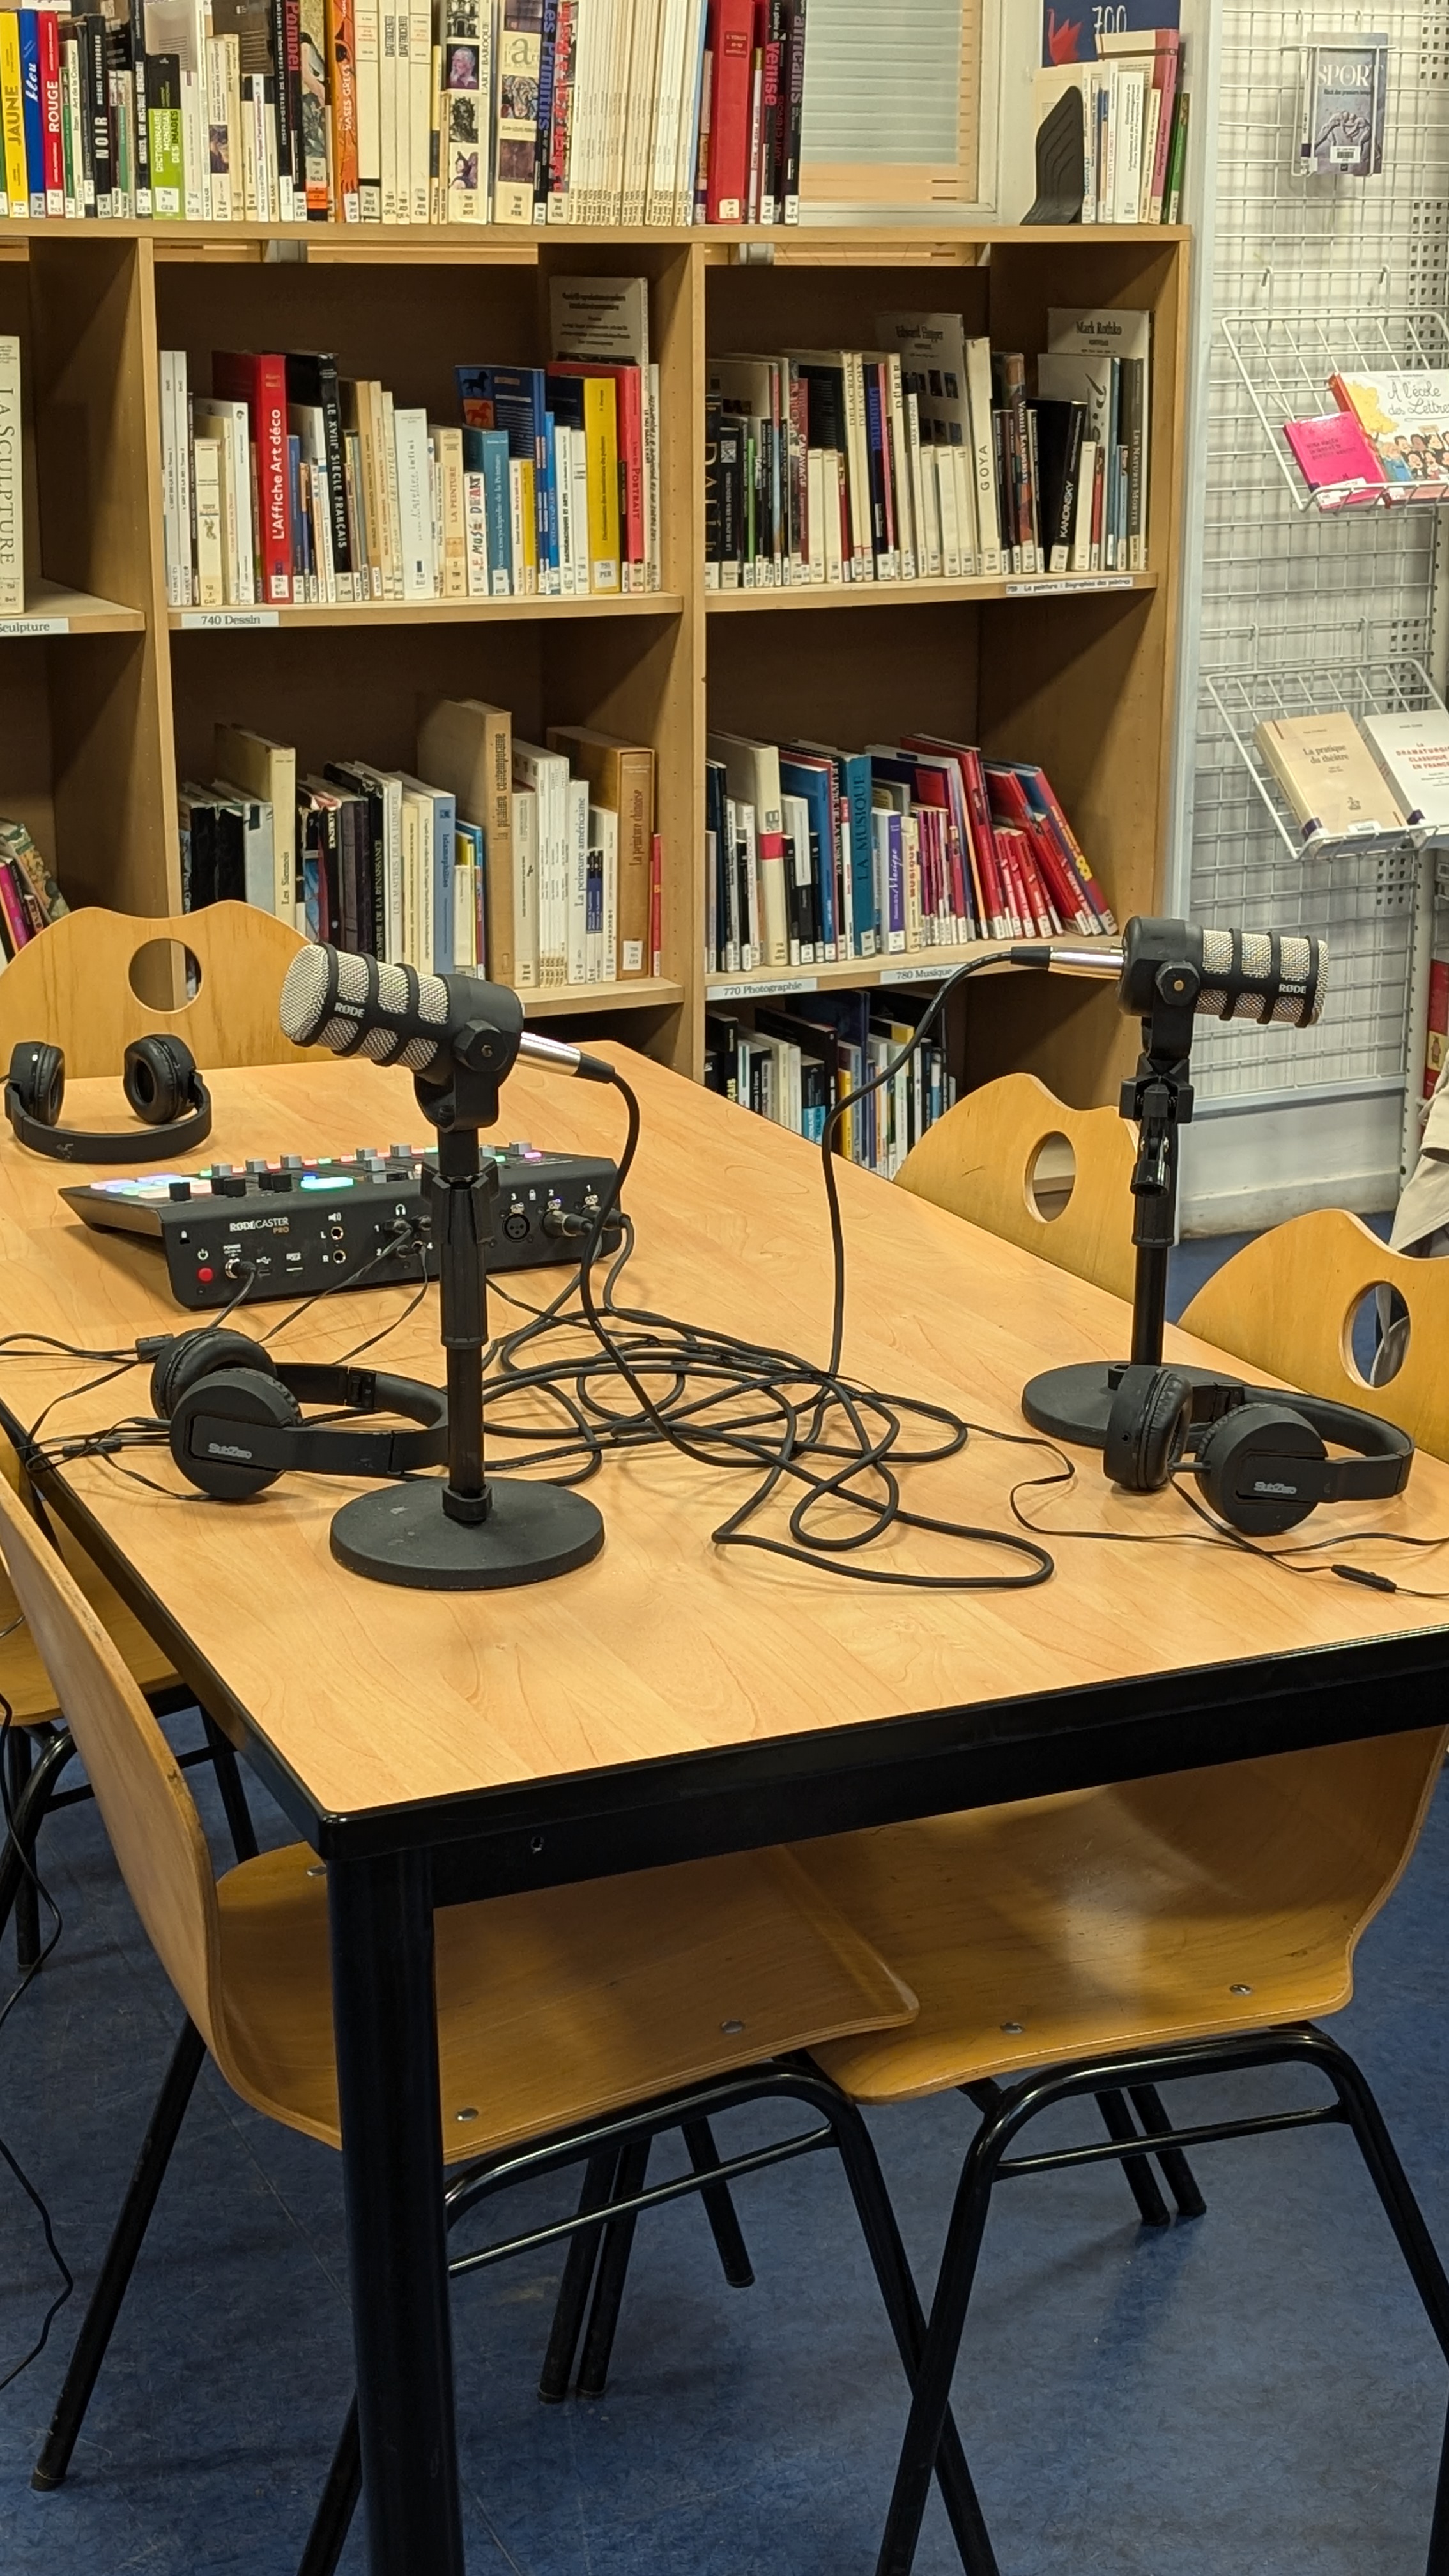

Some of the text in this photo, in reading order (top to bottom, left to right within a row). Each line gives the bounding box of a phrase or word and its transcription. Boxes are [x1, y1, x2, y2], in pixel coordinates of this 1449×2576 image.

[481, 22, 489, 65] BAROQUE
[1092, 5, 1127, 34] 700
[341, 64, 352, 132] VASES GRECS
[765, 42, 780, 105] Venise
[5, 86, 21, 146] JAUNE
[47, 80, 59, 132] ROUGE
[95, 116, 109, 159] NOIR
[856, 362, 866, 427] DELACROIX
[1388, 404, 1406, 416] des
[270, 408, 283, 540] L'Affiche Art déco
[408, 440, 416, 470] infini
[798, 434, 807, 487] CARAVAGE
[979, 445, 990, 491] GOYA
[1132, 447, 1140, 487] NATURES
[0, 425, 16, 565] SCULPTURE
[448, 466, 458, 523] LA PEINTURE
[632, 468, 640, 519] PORTRAIT
[1059, 480, 1074, 538] KANDINSKY
[1131, 489, 1140, 526] MORTES
[334, 496, 347, 549] FRANÇAIS
[201, 615, 261, 625] 740 Dessin
[1303, 744, 1347, 756] La pratique
[1310, 753, 1349, 764] du théâtre
[1395, 746, 1449, 756] DRAMATURGI
[574, 797, 587, 907] La peinture américaine
[628, 789, 644, 866] La peinture chinoise
[854, 775, 869, 880] LA MUSIQUE
[723, 981, 802, 997] 770 Photographie
[896, 967, 952, 979] 780 Musique
